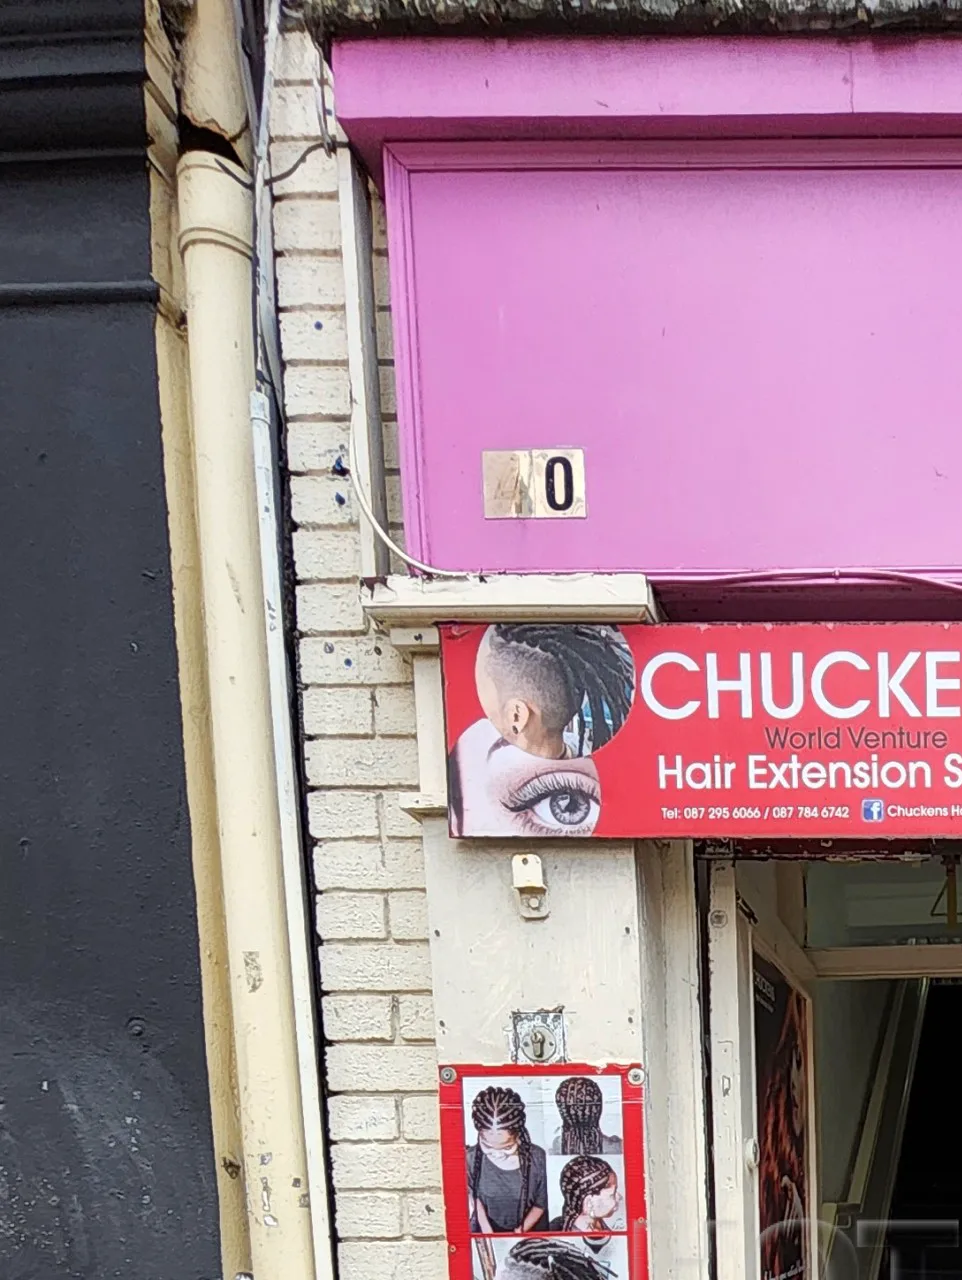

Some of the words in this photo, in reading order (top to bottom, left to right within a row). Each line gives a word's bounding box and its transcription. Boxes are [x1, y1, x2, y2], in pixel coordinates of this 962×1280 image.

[765, 726, 841, 750] World
[848, 726, 948, 749] Venture
[658, 754, 736, 789] Hair
[748, 754, 932, 789] Extension
[660, 807, 681, 820] Tel:
[684, 807, 705, 819] 087
[708, 807, 730, 819] 295
[732, 807, 761, 819] 6066
[772, 806, 795, 819] 087
[798, 806, 819, 818] 784
[821, 806, 850, 819] 6742
[887, 804, 948, 817] Chuckens
